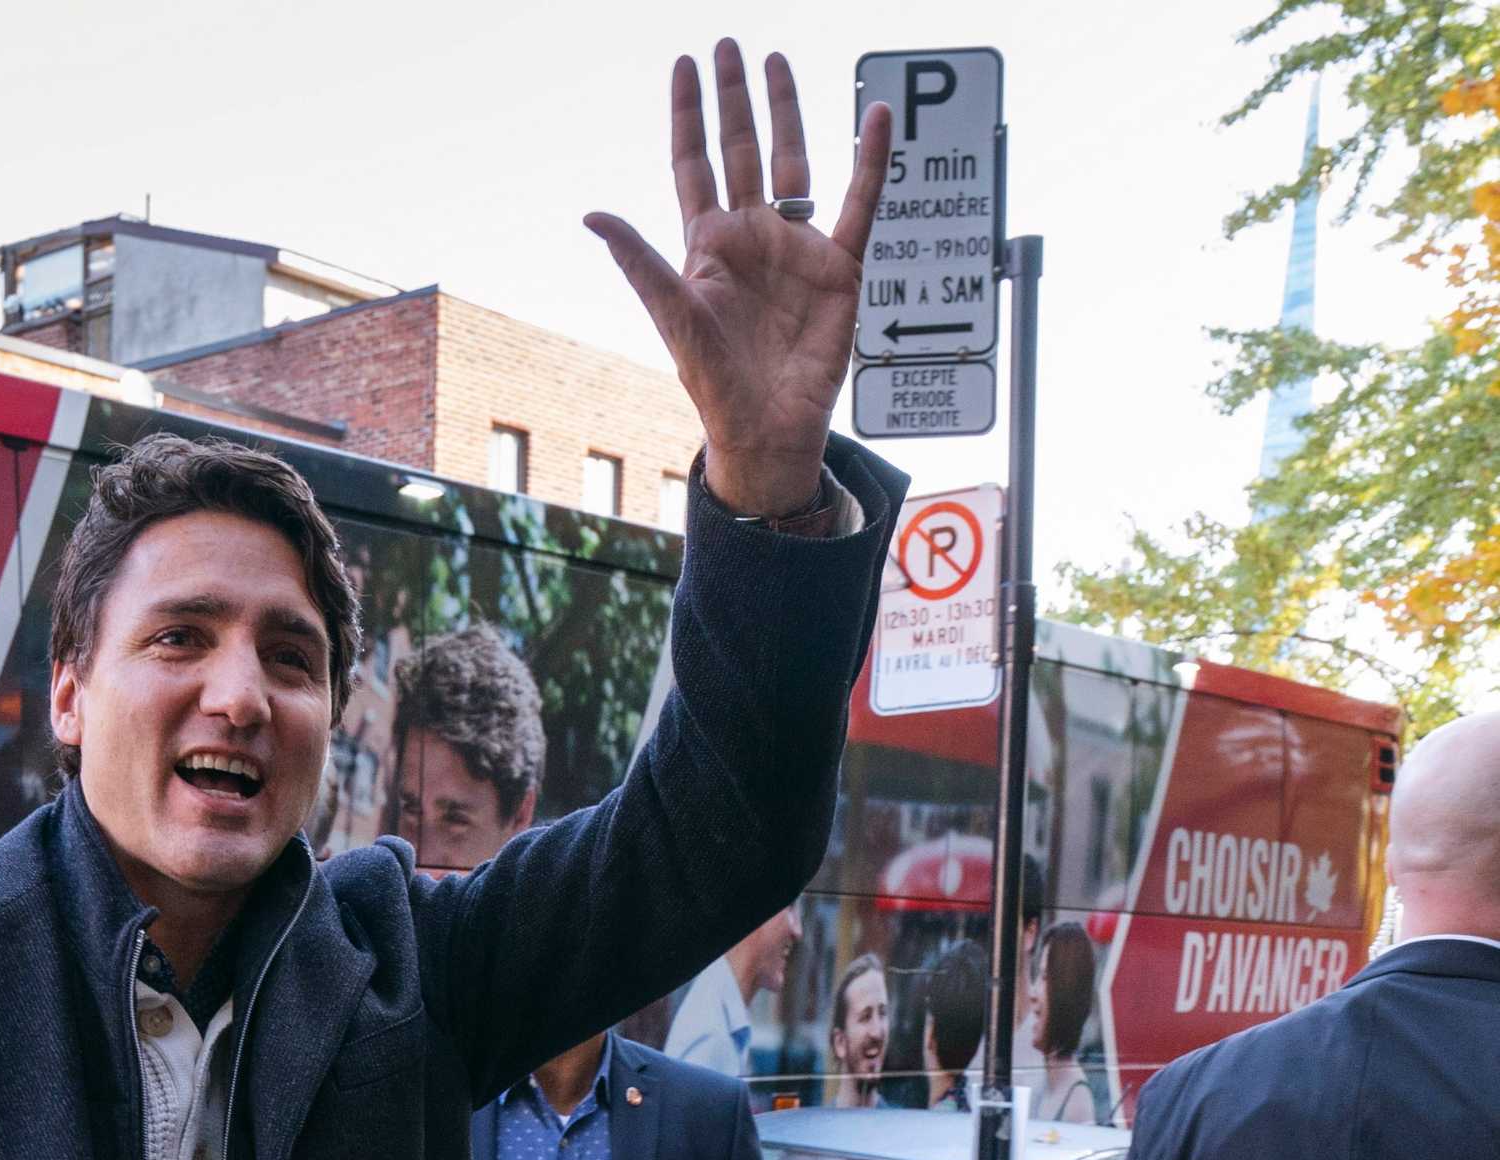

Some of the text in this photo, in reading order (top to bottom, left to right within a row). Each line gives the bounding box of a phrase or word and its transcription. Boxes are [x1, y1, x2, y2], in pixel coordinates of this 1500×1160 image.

[904, 59, 957, 142] P
[884, 148, 977, 184] 5 min
[876, 191, 990, 221] ÉBARCADÈRE
[868, 278, 907, 307] LUN
[941, 275, 984, 304] SAM
[885, 408, 962, 430] INTERDITE
[884, 607, 929, 630] 12h30
[948, 599, 995, 622] 13h30
[913, 626, 963, 648] MARDI
[895, 652, 933, 673] AVRIL
[1164, 827, 1302, 922] CHOISIR
